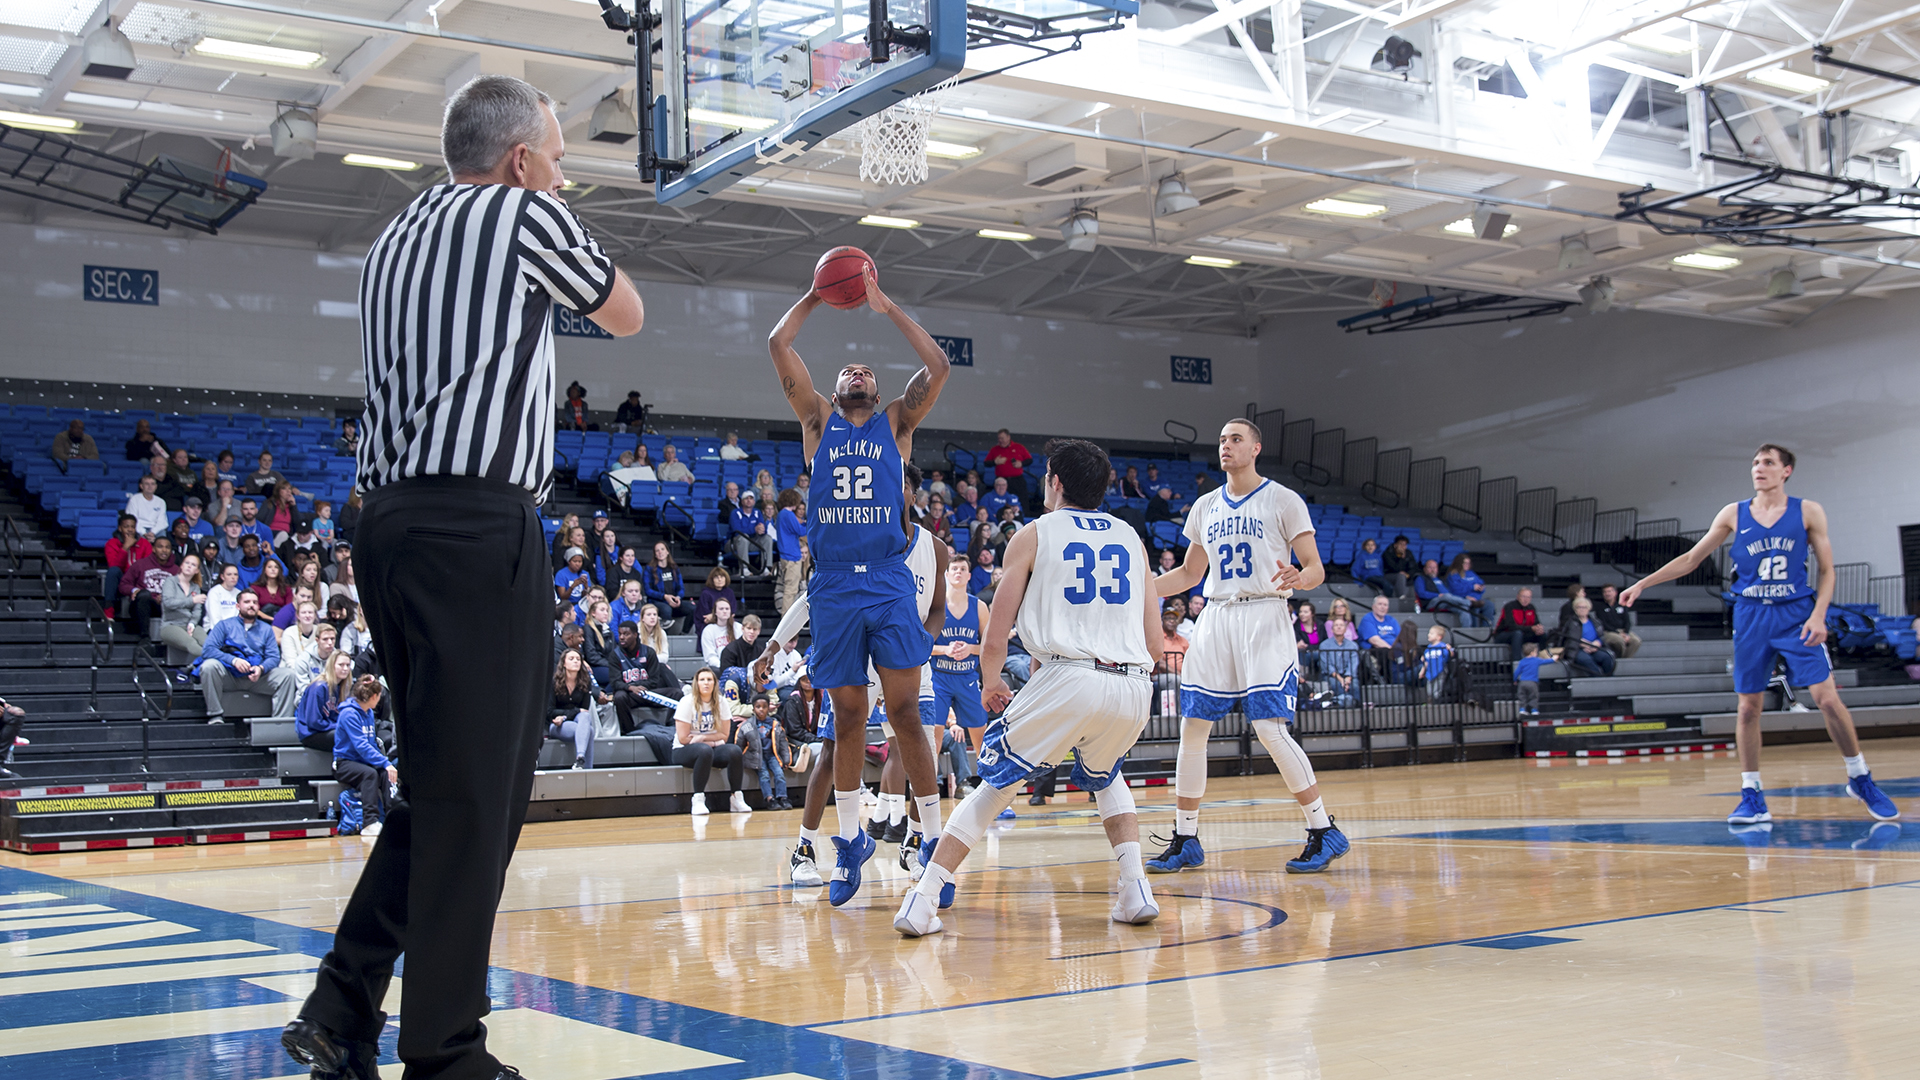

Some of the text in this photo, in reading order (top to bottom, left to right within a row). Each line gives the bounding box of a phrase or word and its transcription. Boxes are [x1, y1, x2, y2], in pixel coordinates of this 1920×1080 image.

[91, 268, 153, 301] SEC. 2
[934, 338, 970, 363] EC. 4
[1174, 358, 1209, 382] SEC. 5
[833, 466, 873, 500] 32
[818, 506, 891, 524] UNIVERSITY
[1208, 516, 1264, 544] SPARTANS
[1746, 536, 1796, 556] MILLIKIN
[854, 565, 867, 573] M
[1062, 541, 1132, 605] 33
[1218, 541, 1253, 581] 23
[1757, 554, 1788, 580] 42
[940, 626, 976, 639] MILLIKIN
[622, 667, 649, 683] USA
[936, 658, 976, 671] UNIVERSITY
[641, 693, 662, 704] BLU
